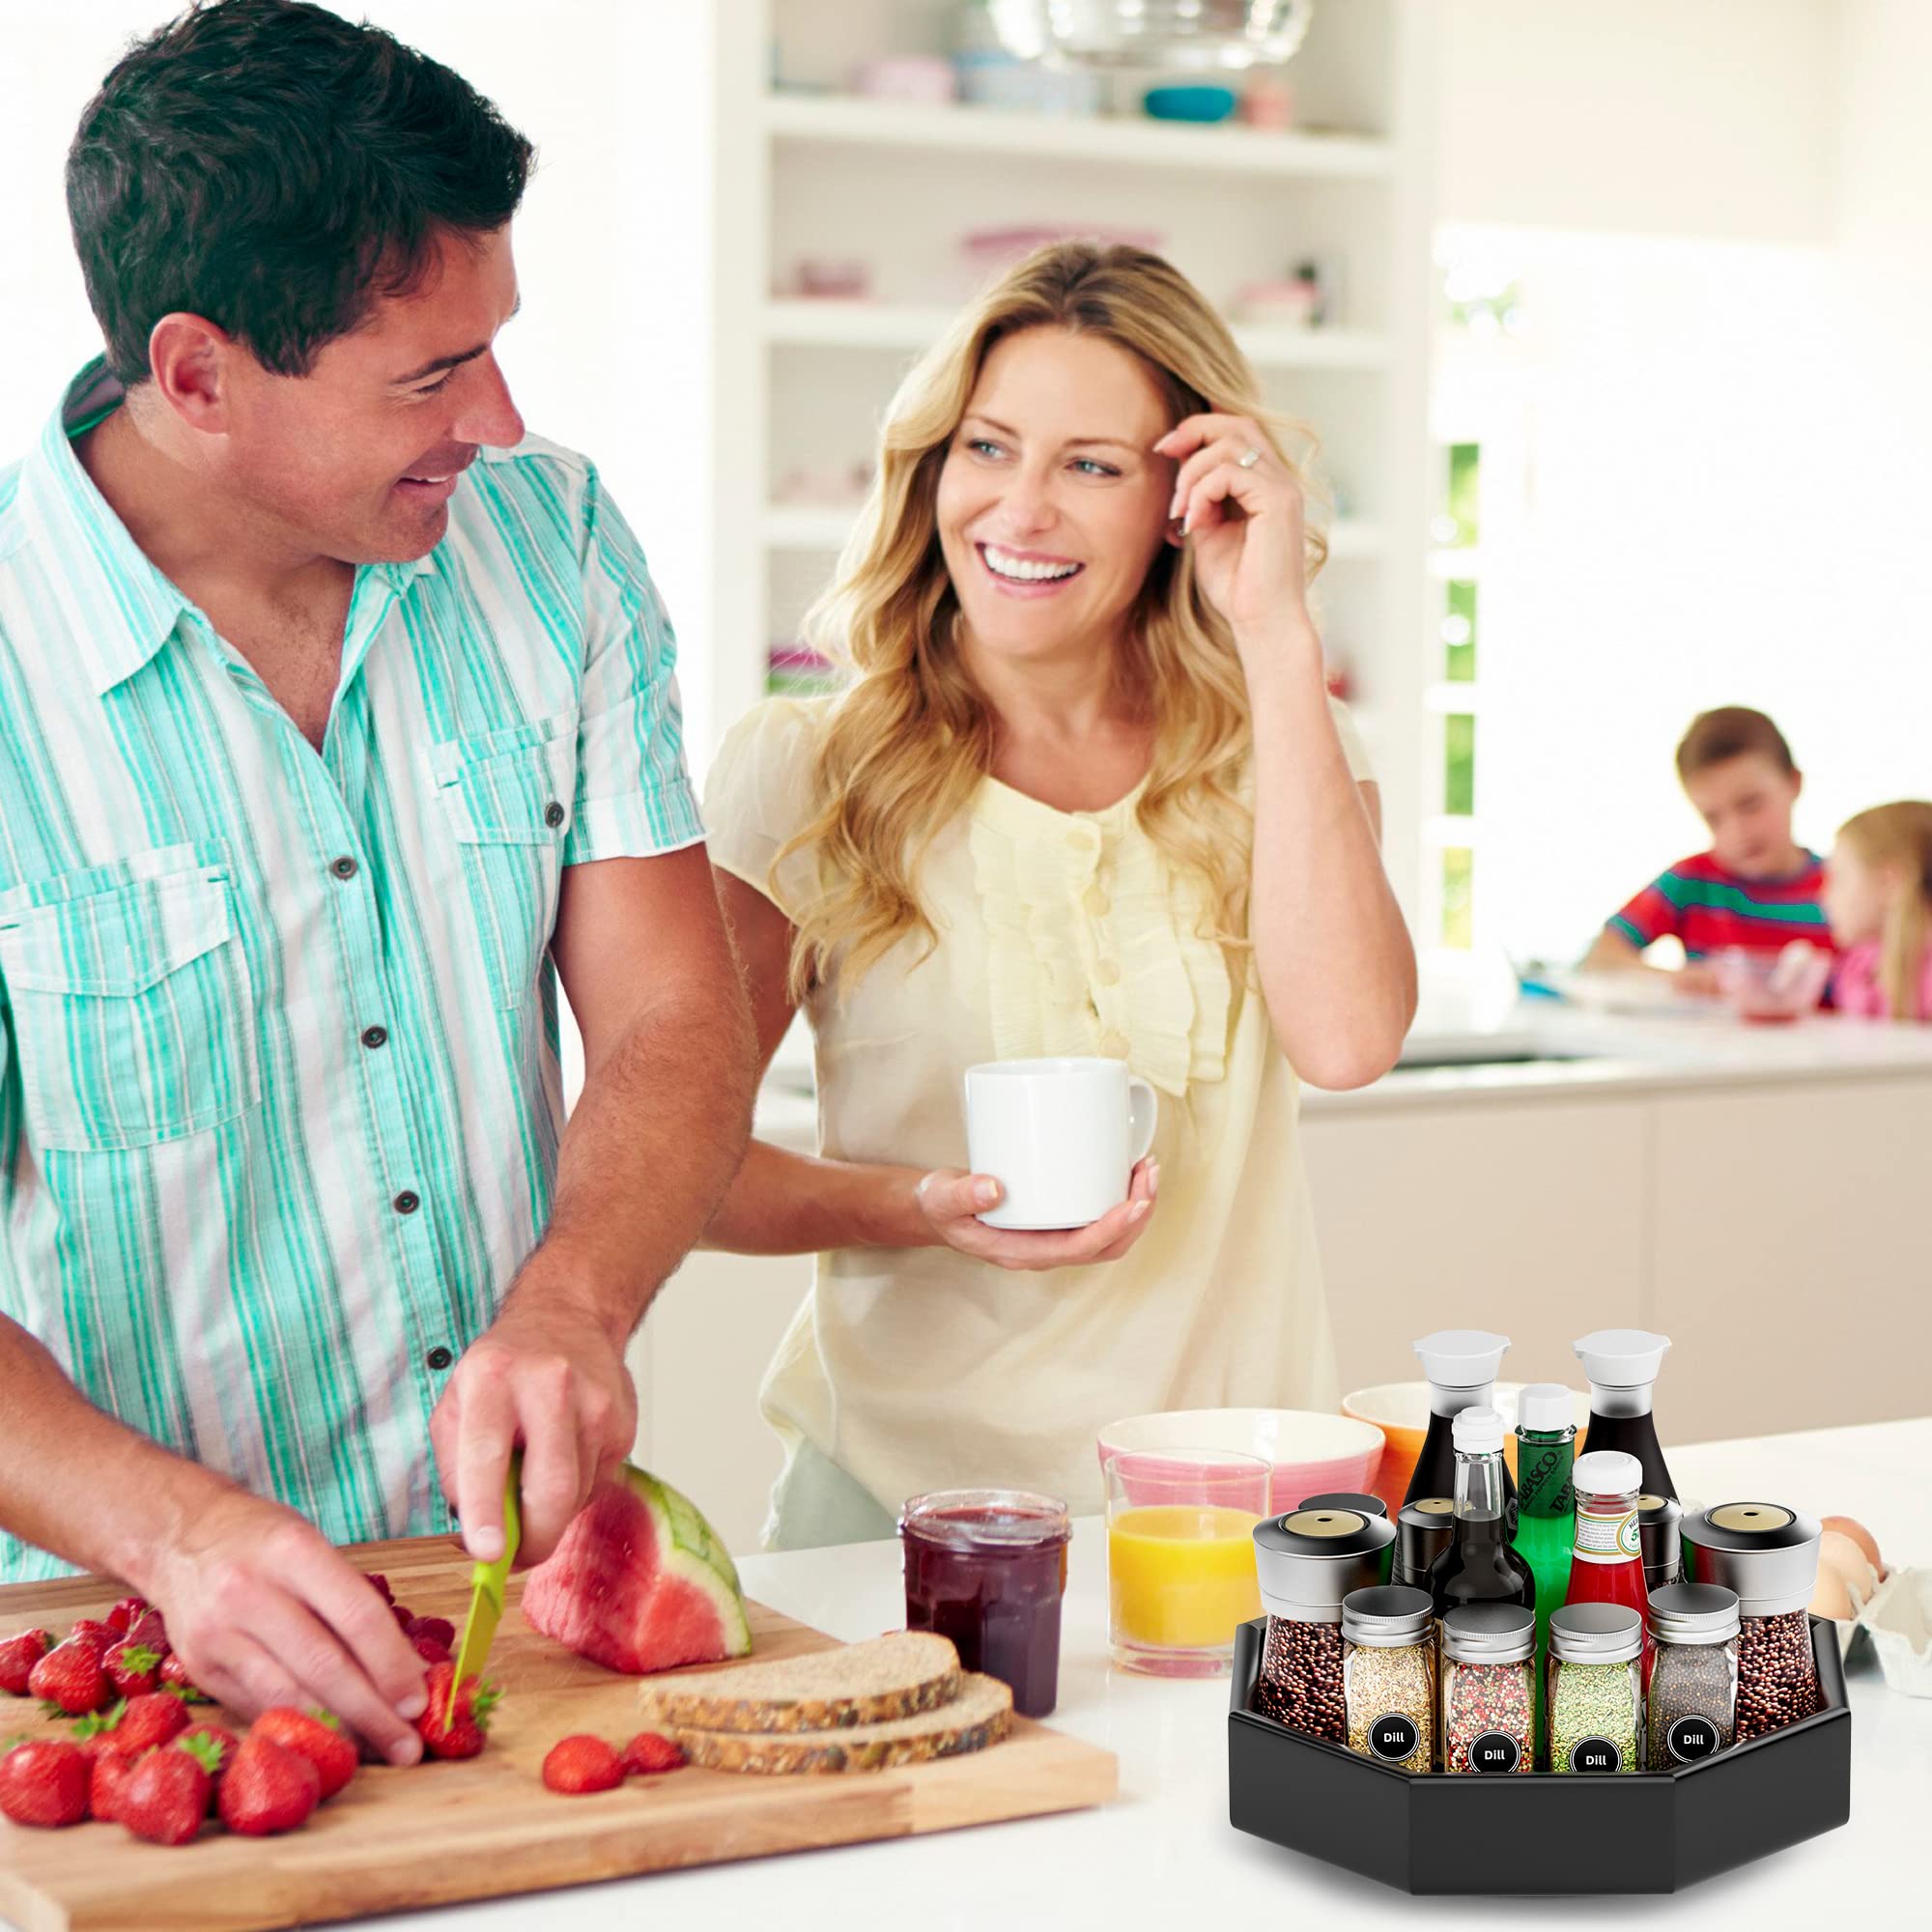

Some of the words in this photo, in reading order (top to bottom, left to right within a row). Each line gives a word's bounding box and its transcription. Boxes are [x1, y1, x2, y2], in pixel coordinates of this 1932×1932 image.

[1518, 1451, 1557, 1509] ABASCO
[1383, 1731, 1405, 1743] Dill
[1684, 1734, 1704, 1746] Dill
[1484, 1748, 1505, 1760] Dill
[1585, 1754, 1606, 1766] Dill
